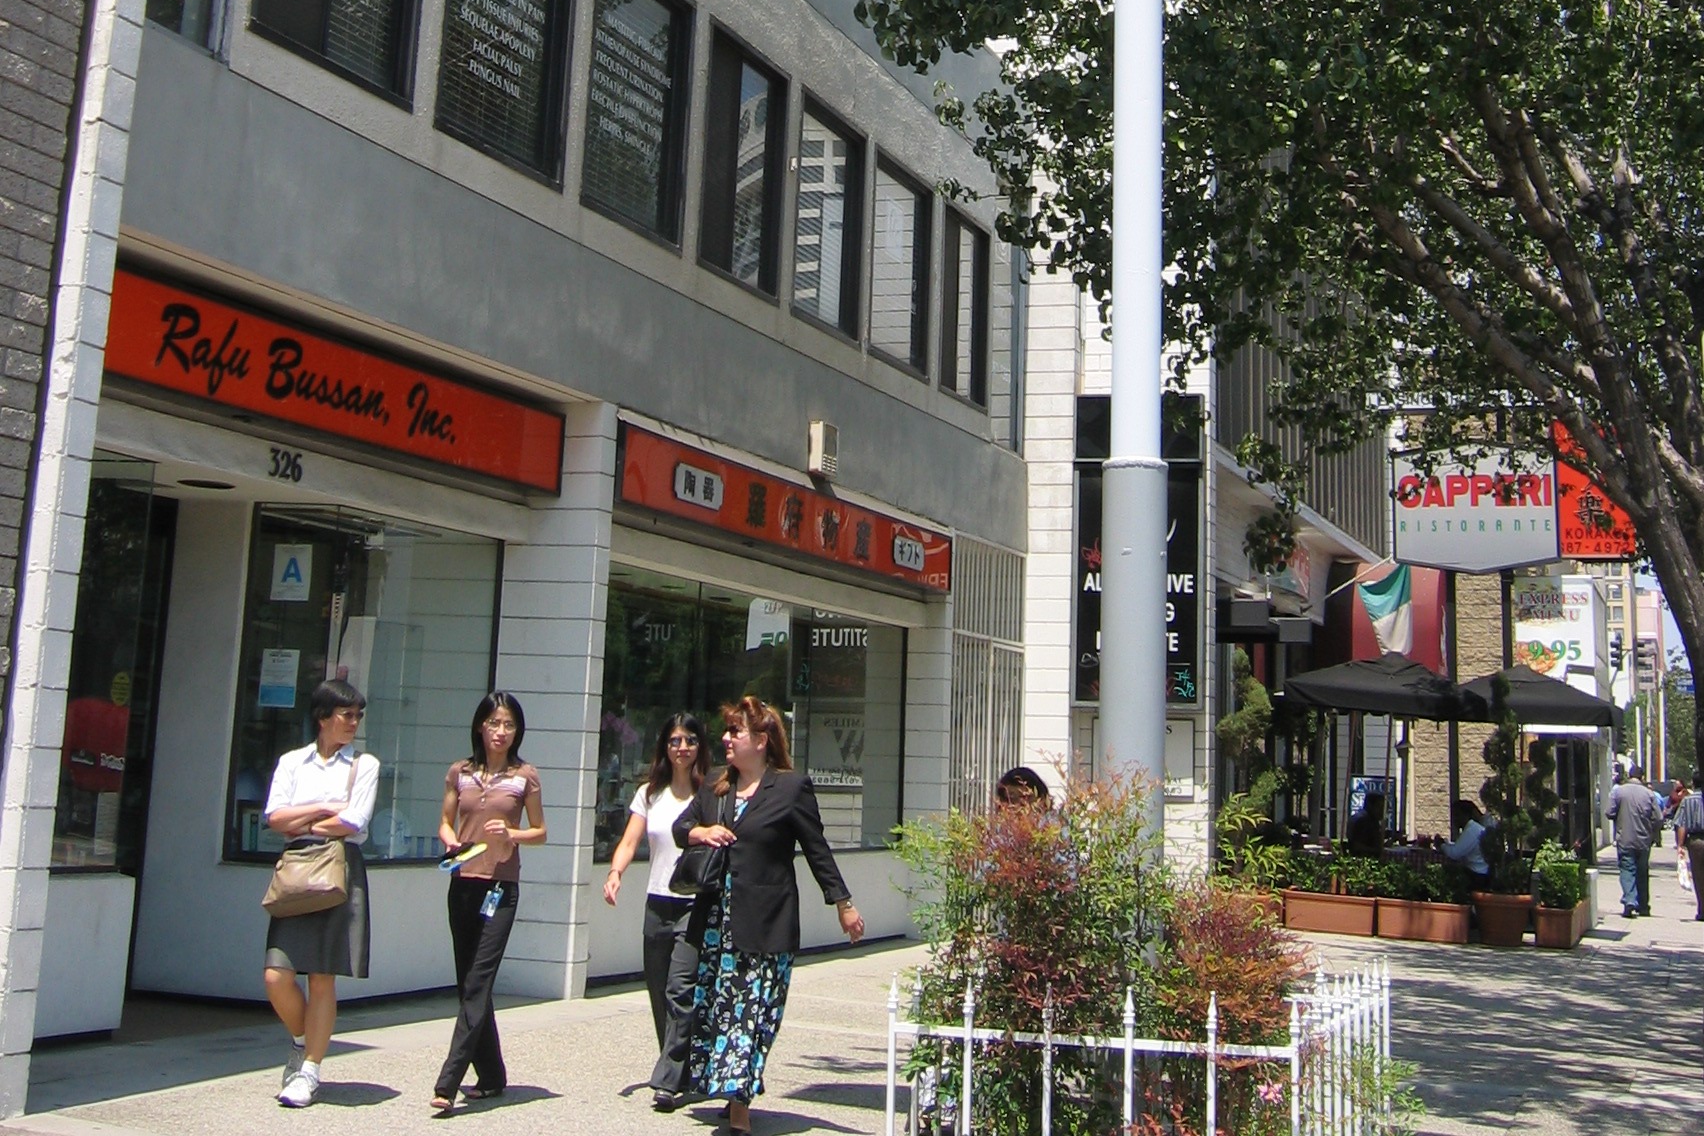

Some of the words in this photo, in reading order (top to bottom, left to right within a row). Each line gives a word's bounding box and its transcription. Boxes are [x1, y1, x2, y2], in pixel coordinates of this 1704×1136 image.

[459, 6, 499, 41] SEQUELAE
[499, 28, 536, 64] APOPLEXY
[508, 13, 539, 43] INJURIES
[473, 38, 501, 66] FACIAL
[500, 54, 523, 78] PALSY
[595, 49, 629, 80] FREQUENT
[468, 59, 502, 88] FUNGUS
[502, 78, 521, 100] NAIL
[154, 303, 252, 396] Rafu
[264, 337, 391, 426] Bussan,
[405, 382, 456, 444] Inc.
[268, 446, 303, 483] 326
[683, 470, 715, 502] 陶器
[1397, 473, 1552, 509] CAPPERI
[1399, 518, 1552, 533] RISTORANTE
[281, 555, 303, 583] A
[1519, 592, 1589, 605] EXPRESS
[1532, 608, 1581, 621] MENU
[1528, 640, 1582, 661] 9.95
